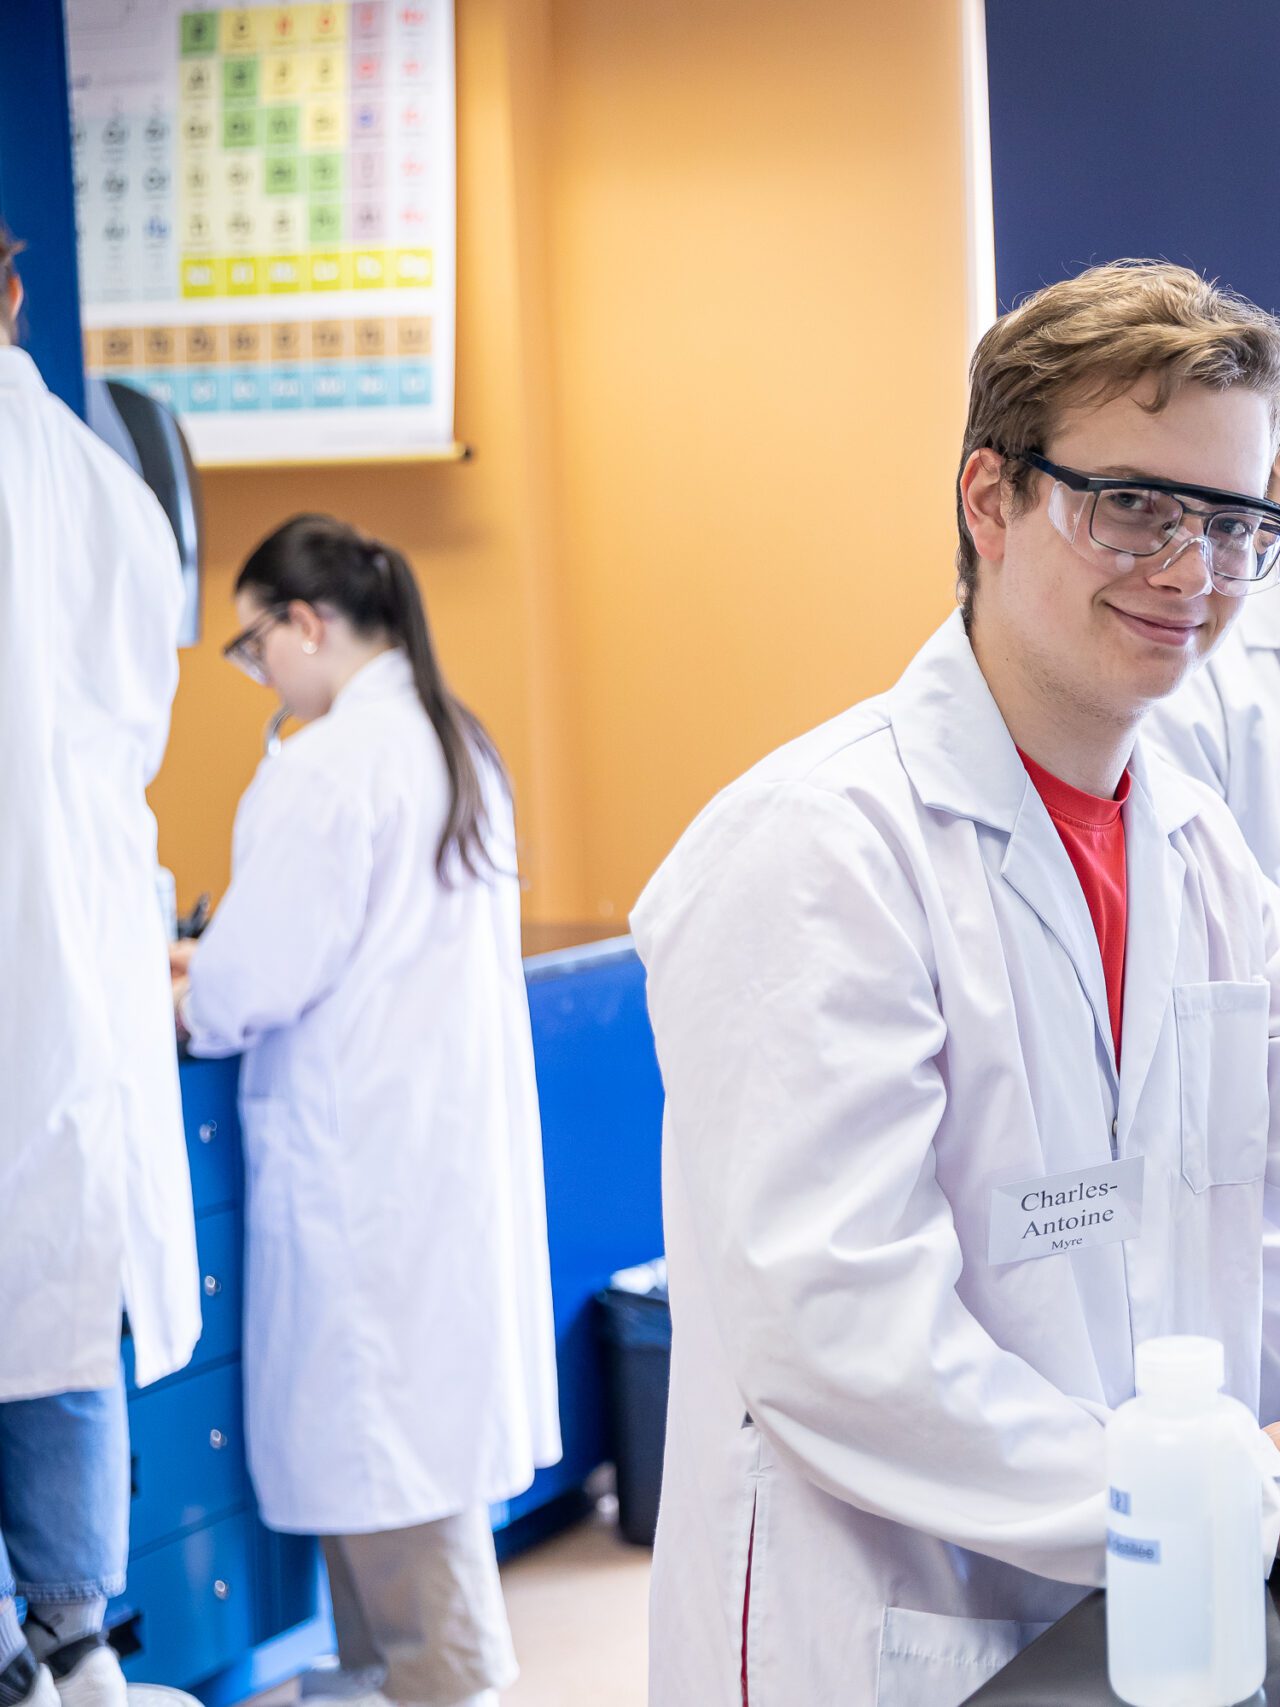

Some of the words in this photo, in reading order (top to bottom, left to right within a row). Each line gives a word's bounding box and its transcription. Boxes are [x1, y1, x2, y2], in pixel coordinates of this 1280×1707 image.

[1020, 1182, 1118, 1212] Charles-
[1021, 1208, 1114, 1240] Antoine
[1050, 1237, 1083, 1250] Myre
